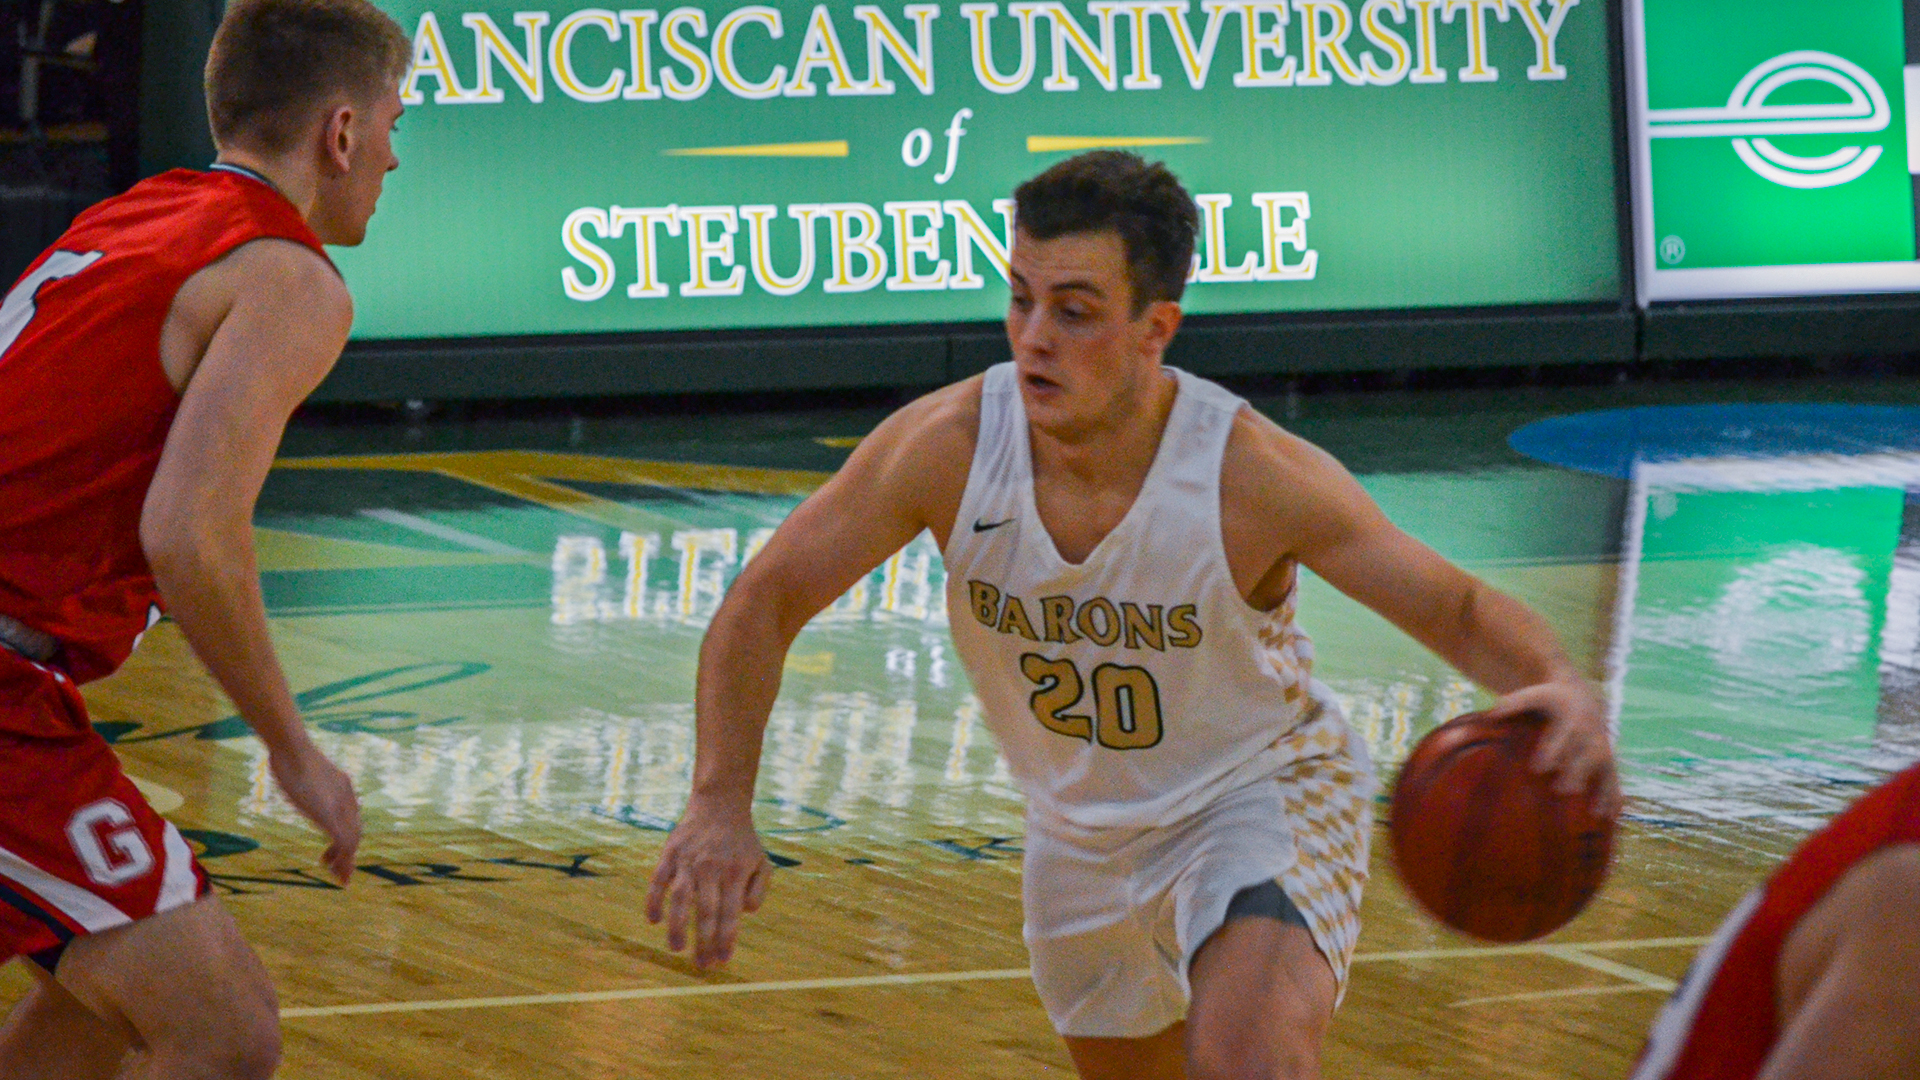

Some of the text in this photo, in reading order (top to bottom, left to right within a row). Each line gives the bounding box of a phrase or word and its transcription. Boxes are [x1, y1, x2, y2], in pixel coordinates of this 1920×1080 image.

[401, 0, 1580, 104] ANCISCAN UNIVERSITY
[901, 108, 973, 183] of
[561, 191, 1319, 301] STEUBENLE
[967, 579, 1203, 651] BARONS
[1020, 652, 1164, 750] 20
[64, 797, 156, 888] G
